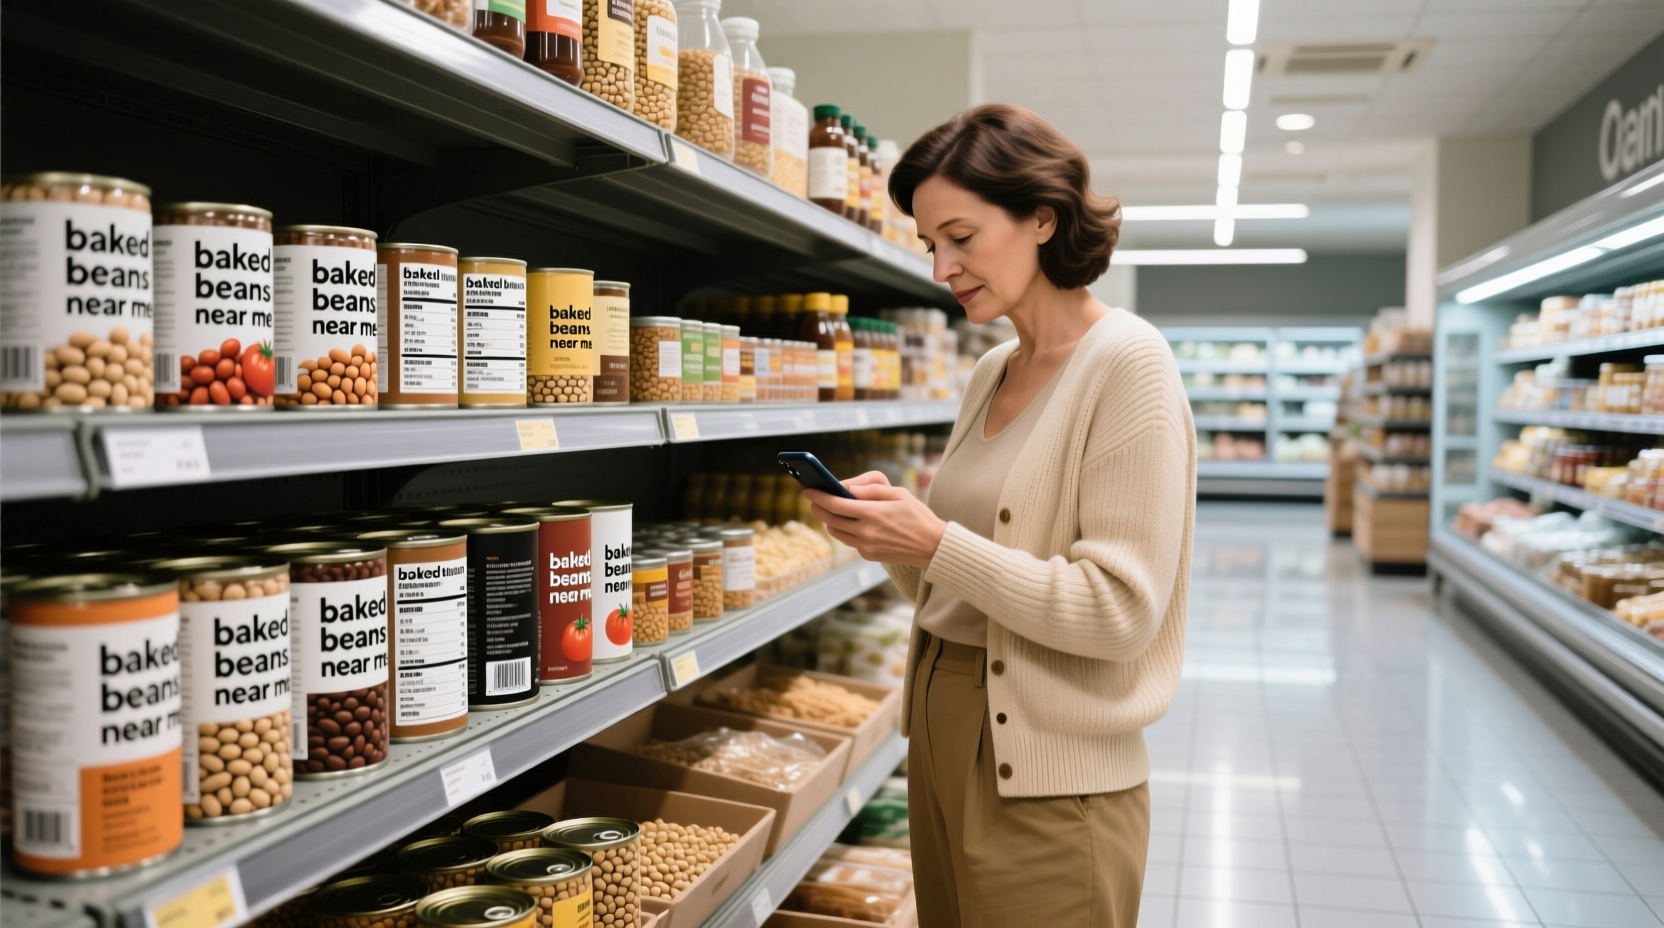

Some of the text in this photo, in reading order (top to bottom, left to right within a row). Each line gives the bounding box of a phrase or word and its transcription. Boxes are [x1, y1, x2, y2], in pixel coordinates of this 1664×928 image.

[66, 219, 149, 258] baked
[195, 240, 271, 273] baked
[67, 256, 149, 290] beans
[195, 272, 271, 302] beans
[312, 259, 376, 288] baked
[67, 296, 126, 315] near
[313, 287, 376, 314] beans
[550, 304, 591, 320] baked
[196, 308, 272, 328] near me
[312, 319, 357, 335] near
[550, 320, 591, 335] beans
[550, 338, 579, 349] near
[550, 549, 591, 569] baked
[320, 590, 386, 623] baked
[214, 609, 288, 646] baked
[321, 626, 386, 652] beans
[100, 631, 180, 676] baked
[215, 648, 289, 678] beans
[321, 657, 370, 678] near
[101, 675, 180, 713] beans
[215, 683, 270, 705] near
[101, 716, 162, 745] near
